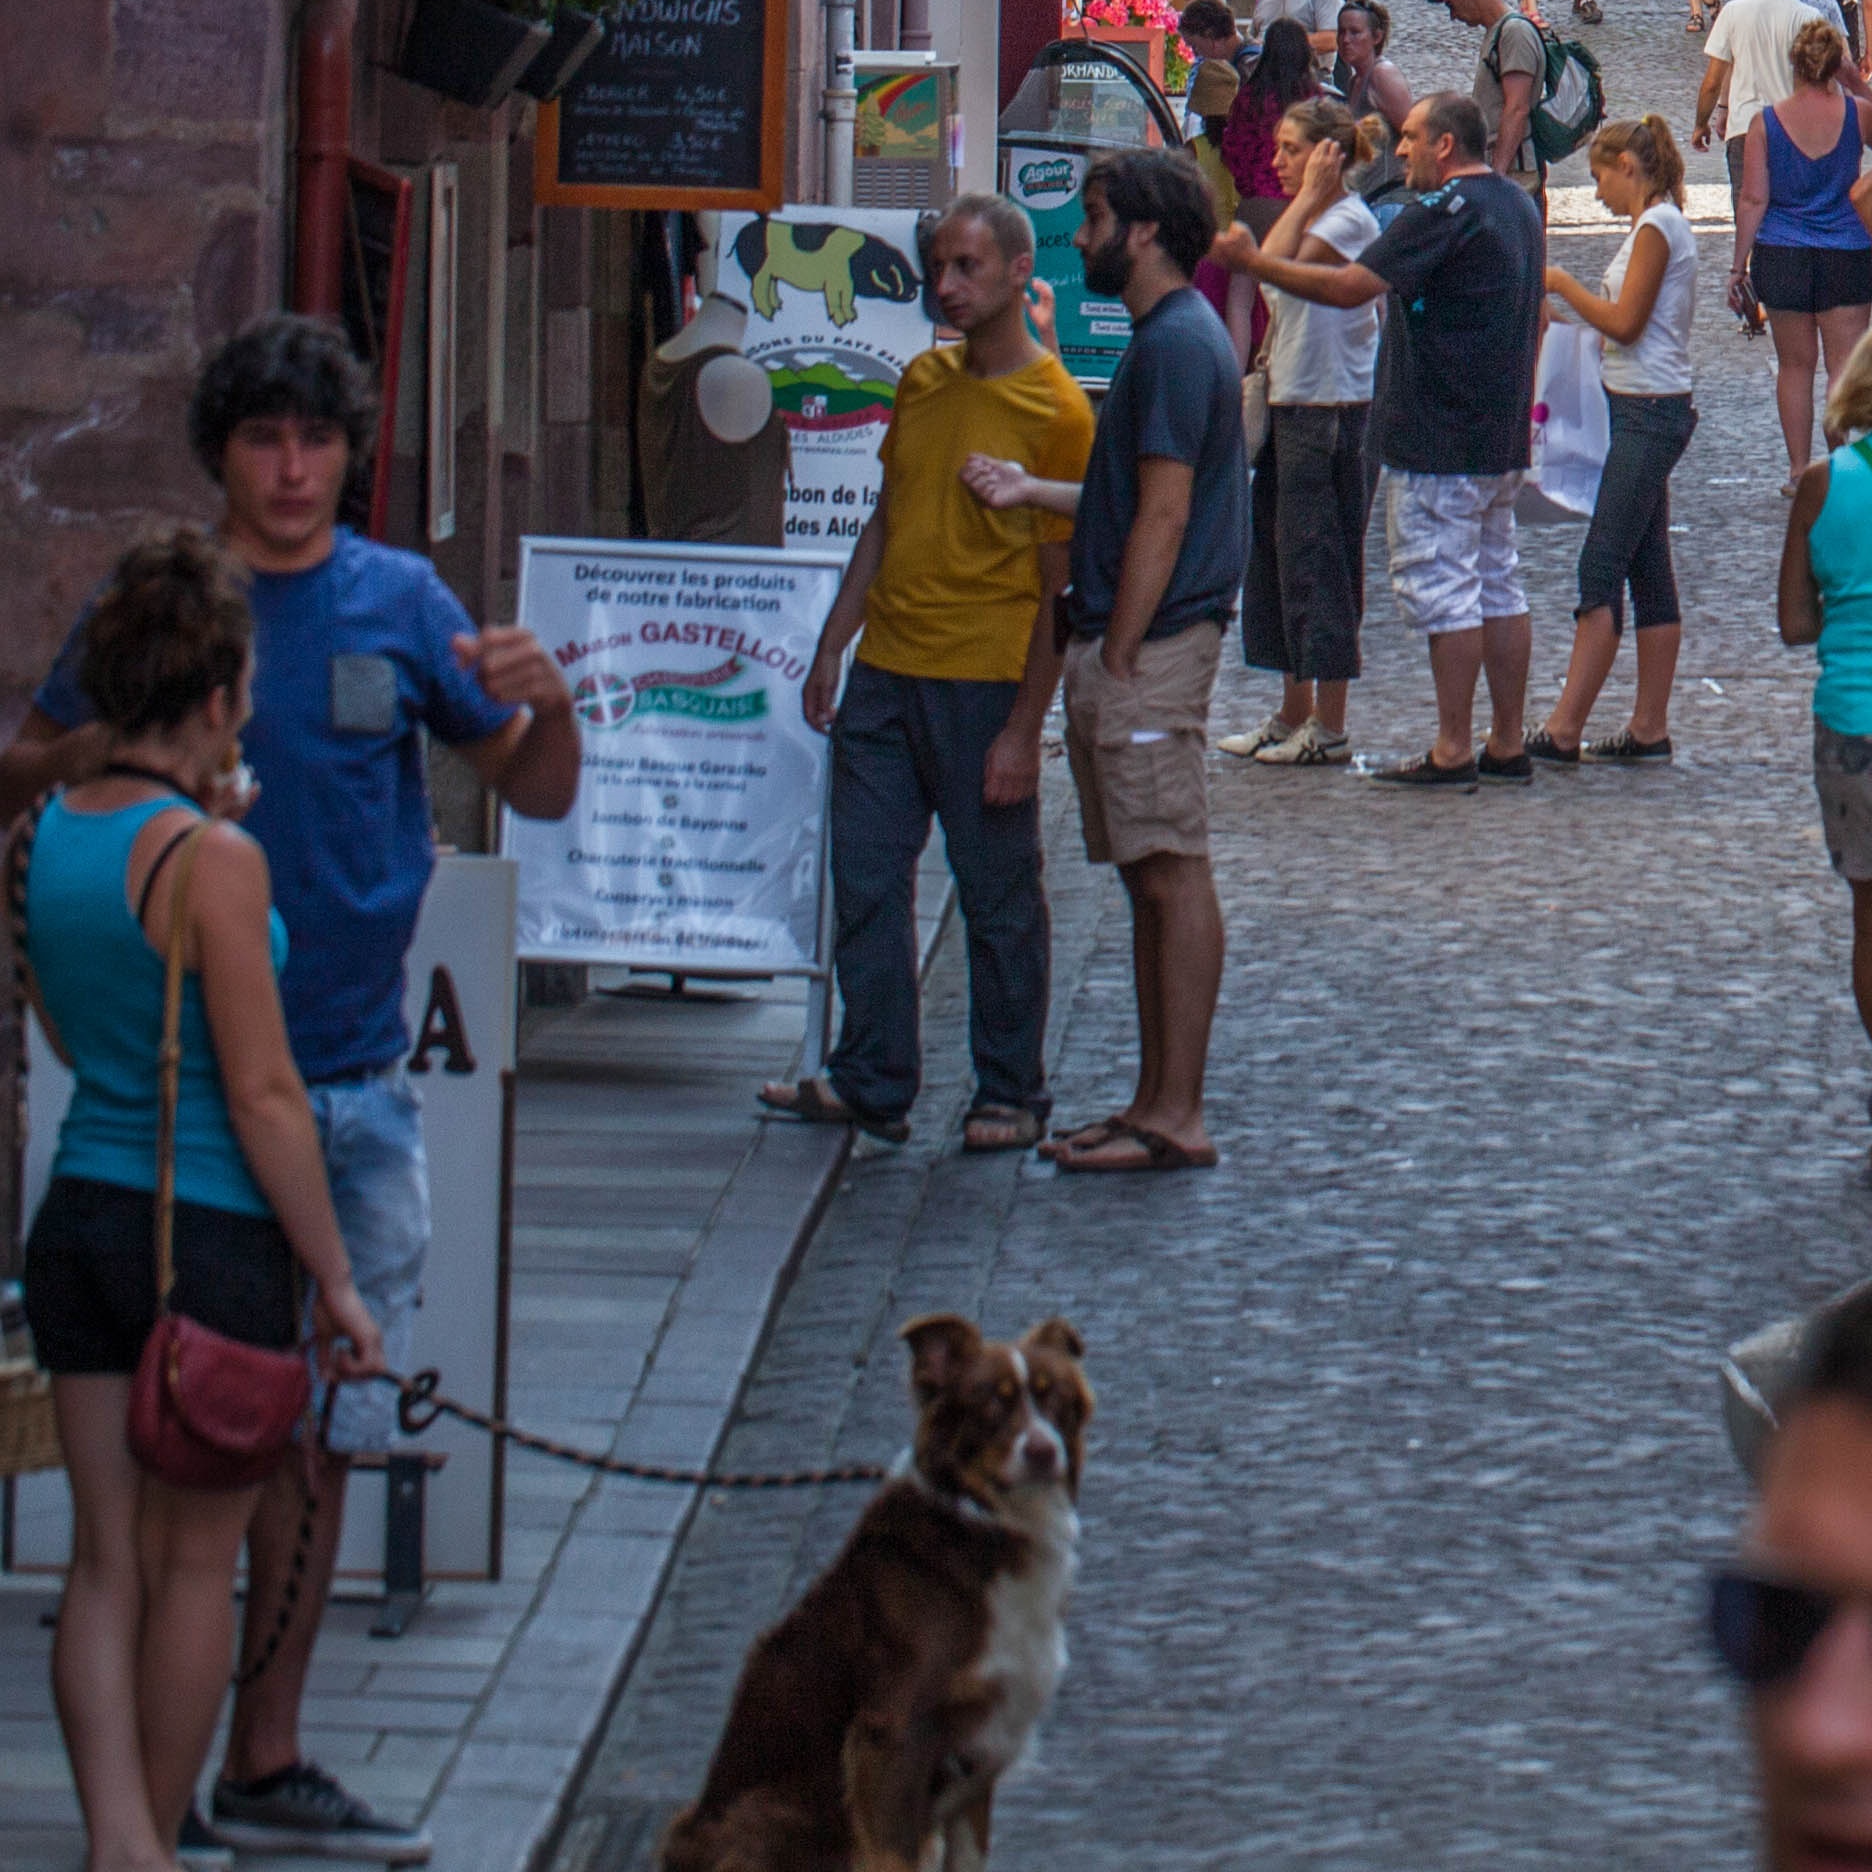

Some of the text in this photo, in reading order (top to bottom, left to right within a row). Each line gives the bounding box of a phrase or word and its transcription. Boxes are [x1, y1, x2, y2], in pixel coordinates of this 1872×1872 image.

[832, 484, 857, 505] de
[574, 562, 796, 592] Découvrez les produits
[585, 587, 781, 613] de notre fabrication
[640, 620, 806, 682] GASTELLOU
